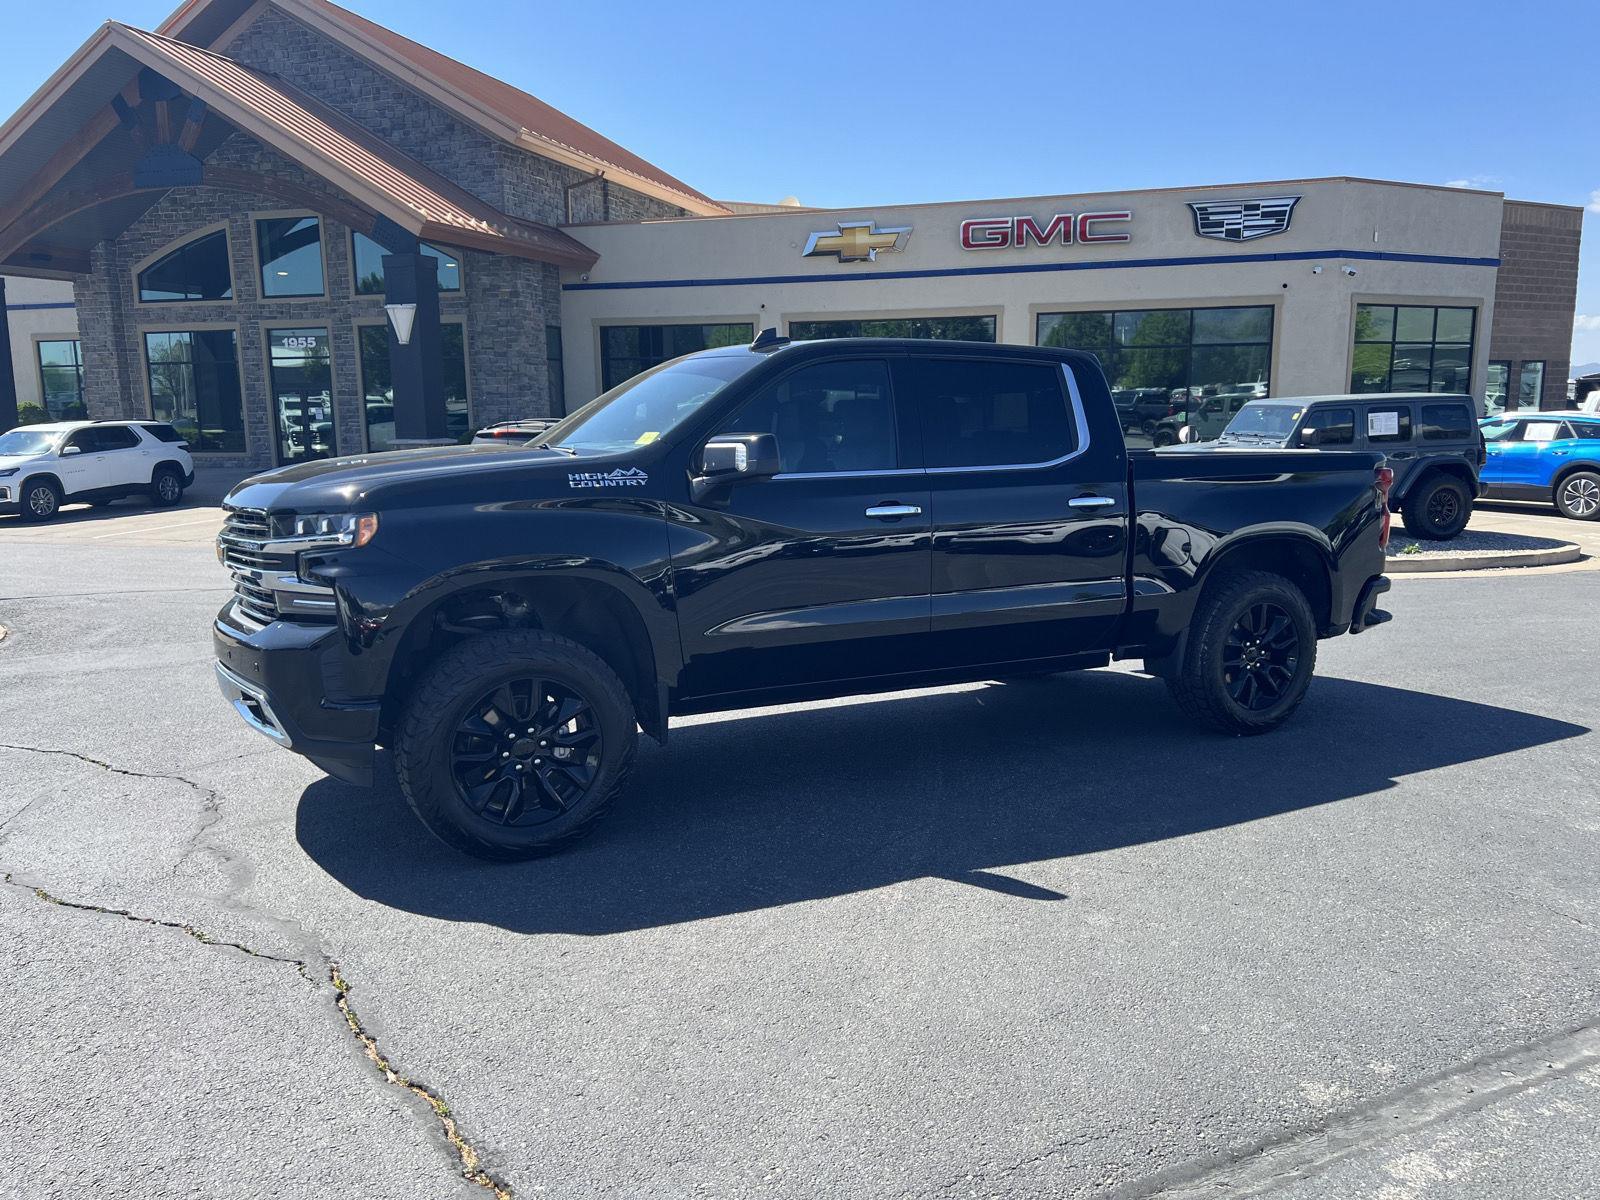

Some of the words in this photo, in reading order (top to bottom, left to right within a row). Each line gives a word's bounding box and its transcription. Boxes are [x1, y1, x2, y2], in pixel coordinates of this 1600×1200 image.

[960, 211, 1131, 250] GMC
[281, 337, 317, 348] 1955
[569, 479, 648, 488] COUNTRY
